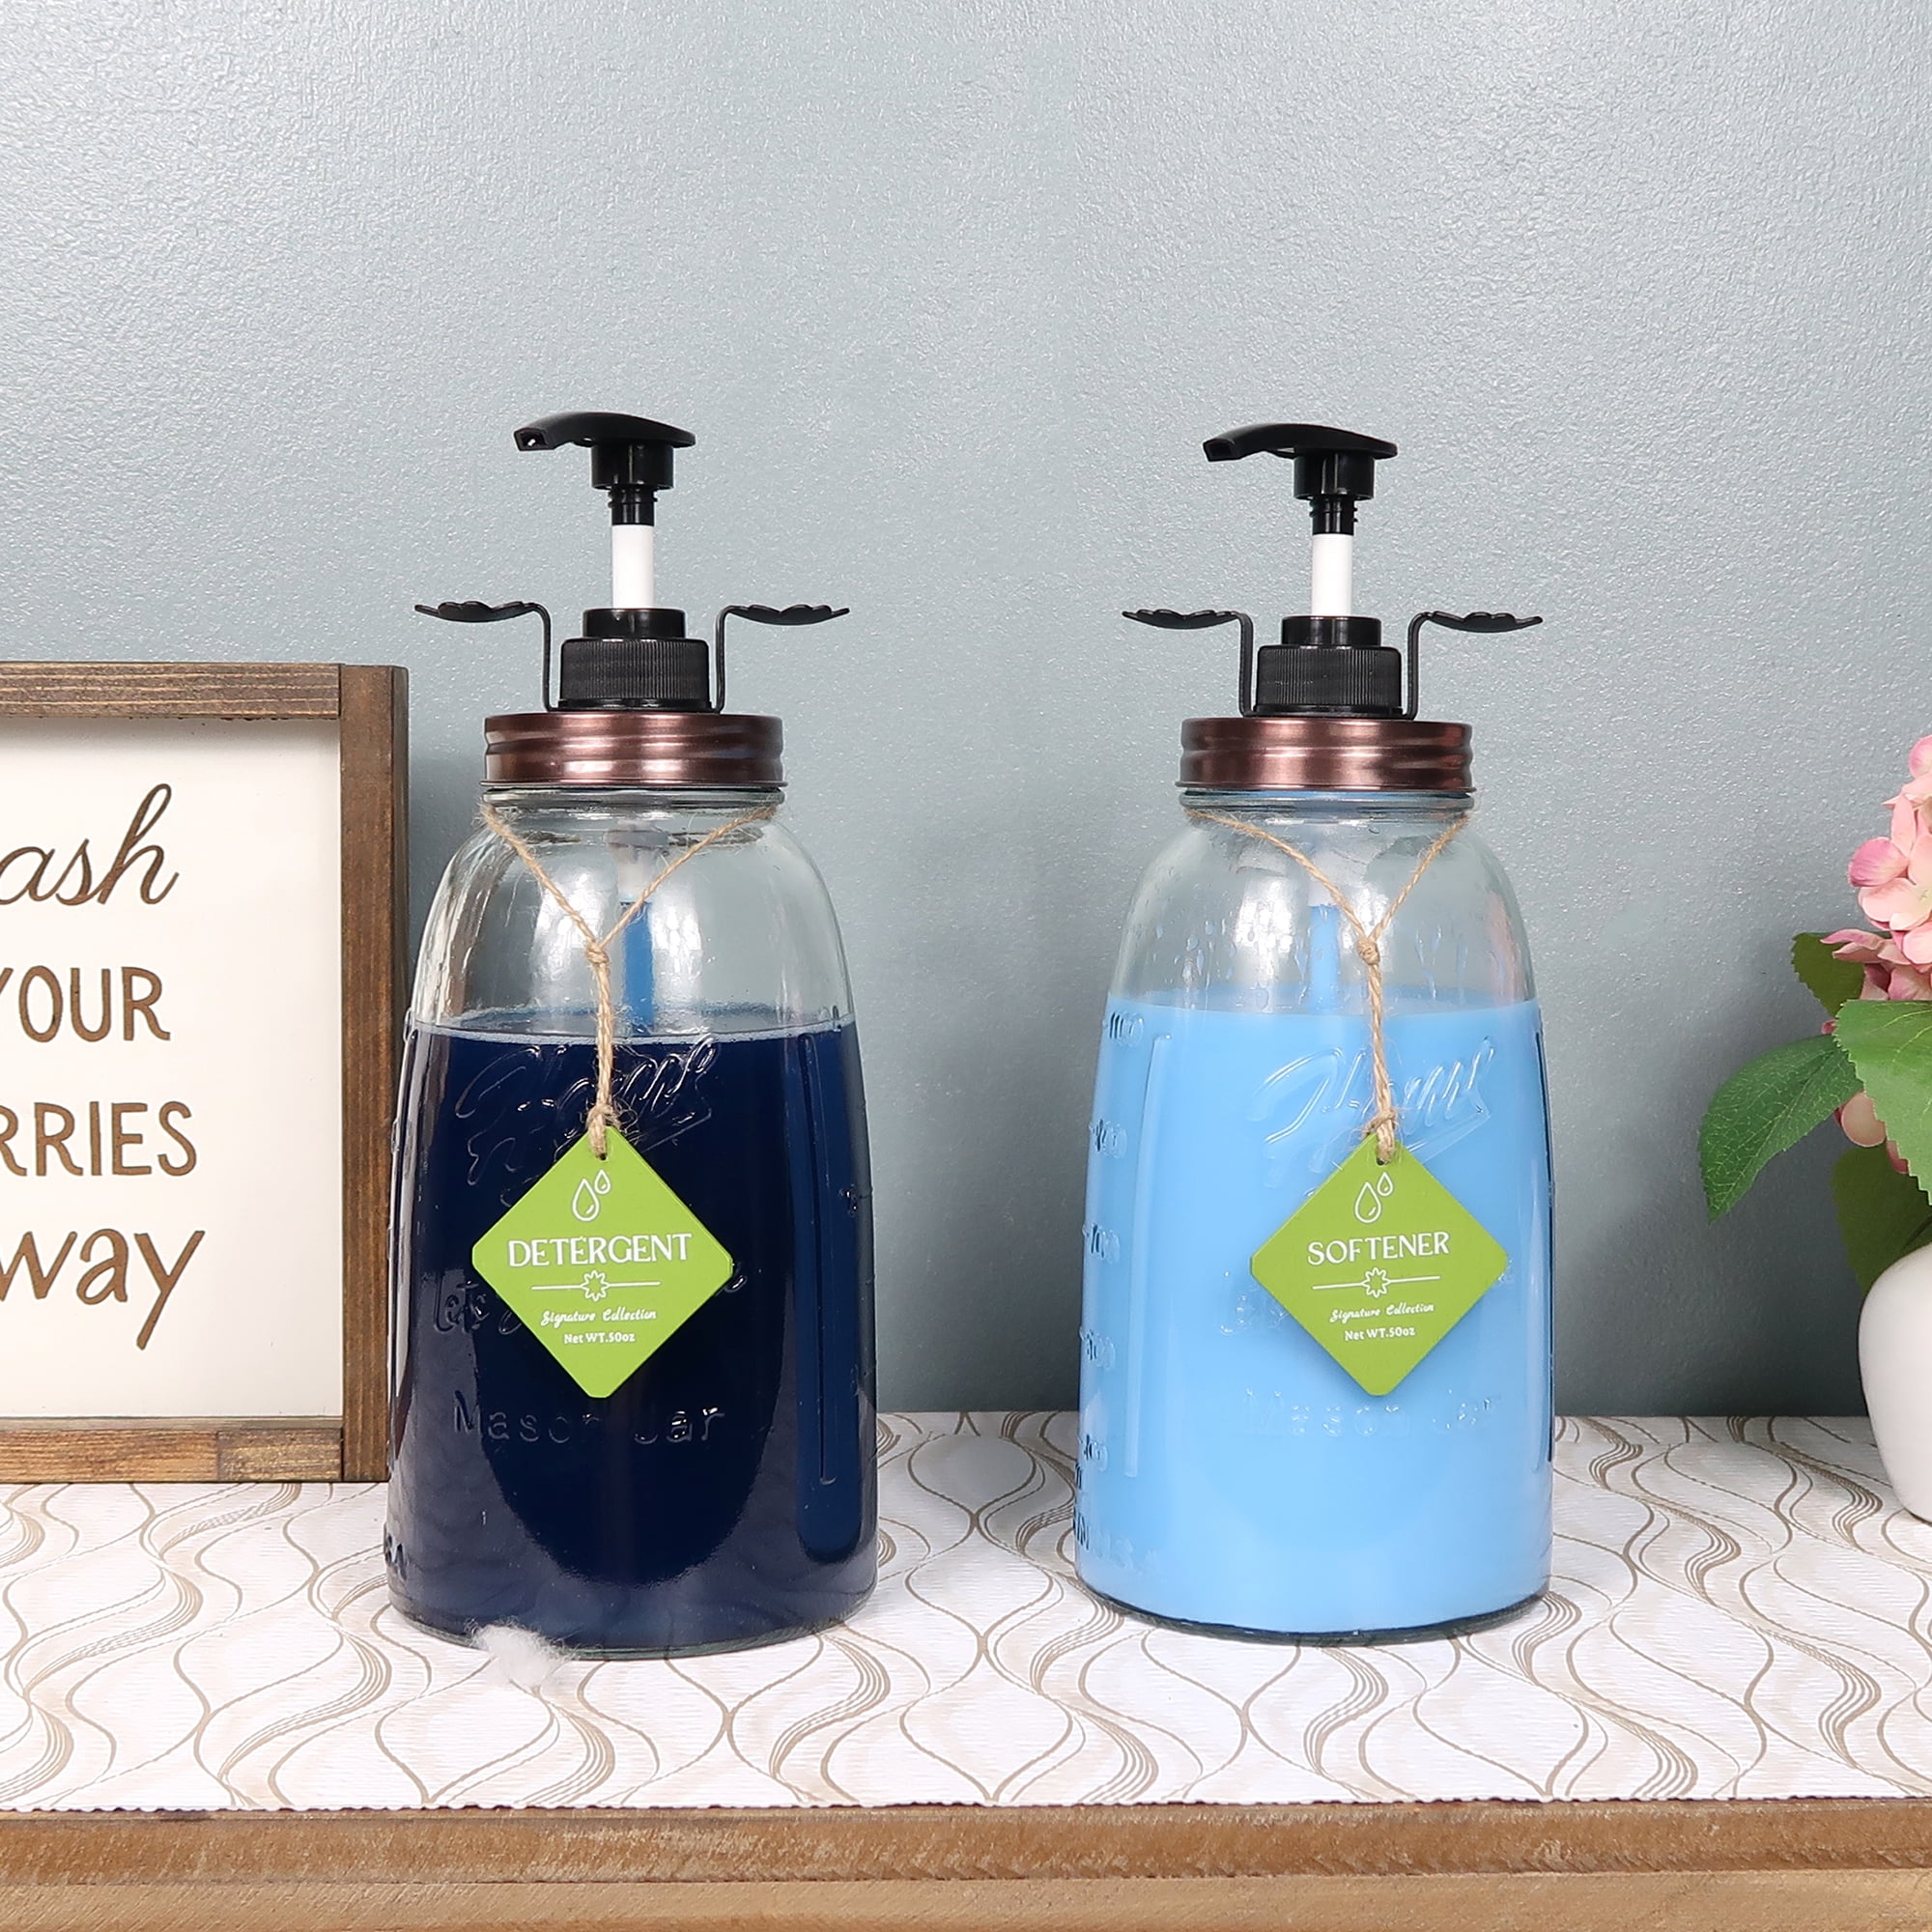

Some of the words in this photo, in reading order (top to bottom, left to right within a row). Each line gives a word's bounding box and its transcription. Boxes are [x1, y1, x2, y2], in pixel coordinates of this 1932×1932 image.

[507, 1233, 693, 1268] DETERGENT
[1307, 1231, 1451, 1266] SOFTENER
[540, 1310, 596, 1329] Signature
[602, 1306, 658, 1321] Collection
[1329, 1307, 1381, 1324] Signature
[1385, 1301, 1435, 1316] Collection
[563, 1333, 583, 1345] Net
[584, 1331, 636, 1344] WT.50oz
[1344, 1329, 1365, 1342] Net
[1366, 1326, 1416, 1339] WT.50oz
